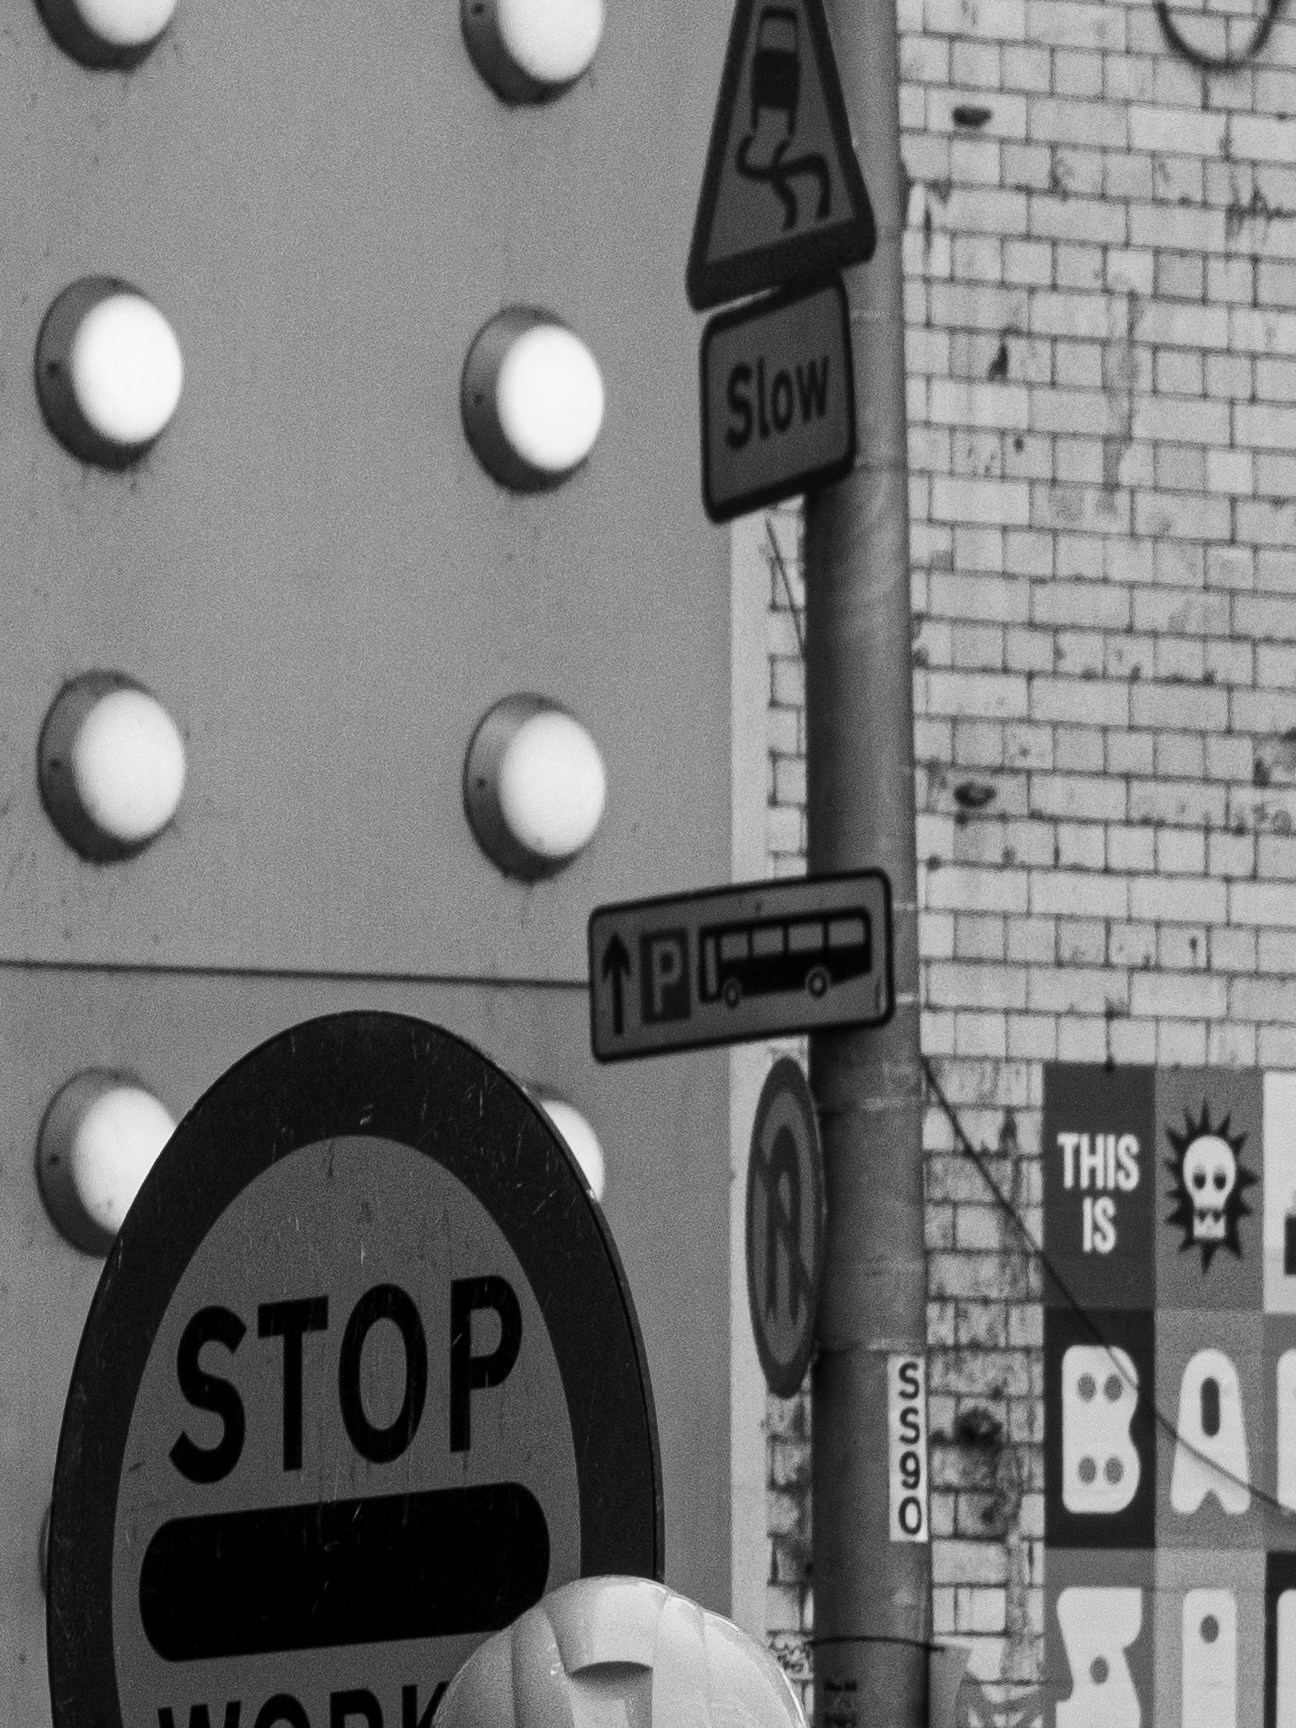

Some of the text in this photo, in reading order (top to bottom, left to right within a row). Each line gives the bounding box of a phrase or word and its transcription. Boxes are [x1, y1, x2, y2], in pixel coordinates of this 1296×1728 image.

[724, 356, 830, 450] Slow
[648, 937, 686, 1017] P
[1057, 1131, 1141, 1192] THIS
[1081, 1196, 1118, 1254] IS
[168, 1275, 523, 1485] STOP
